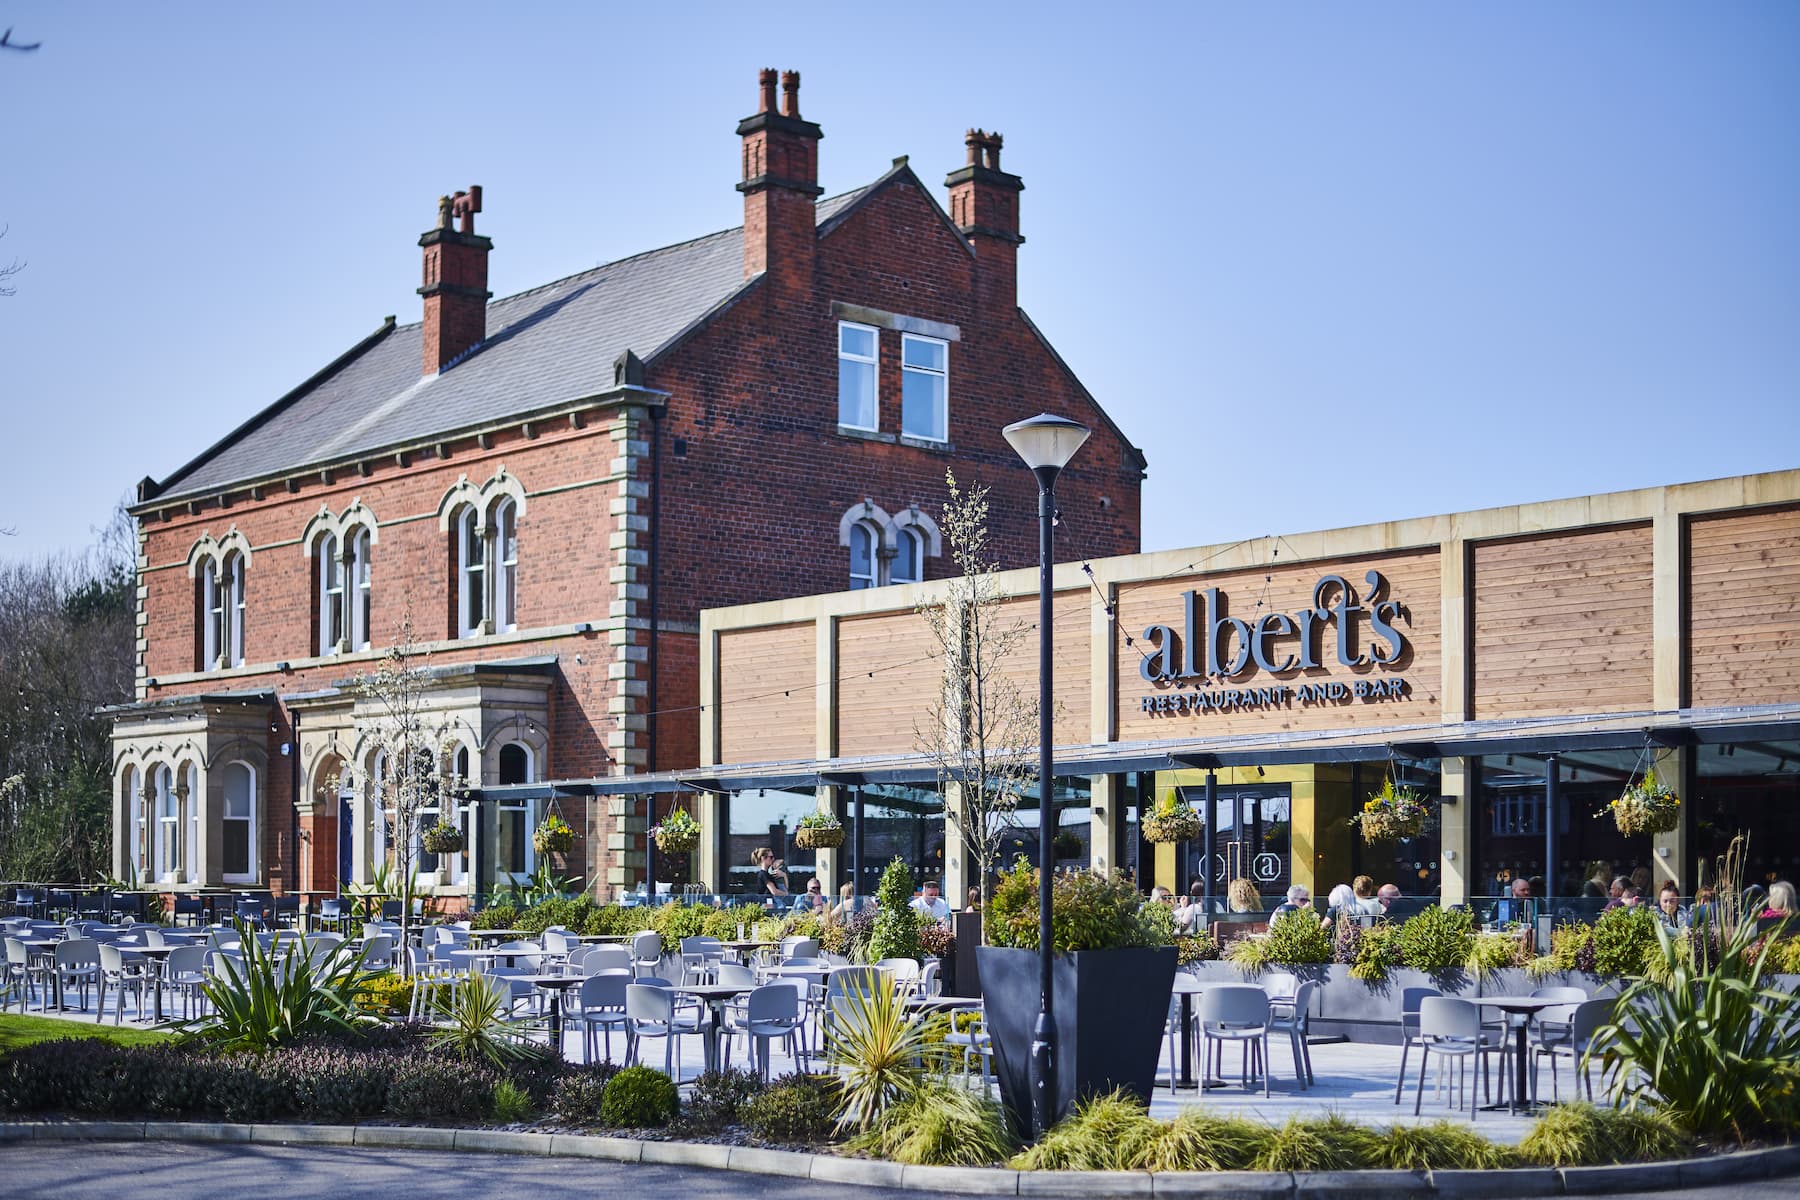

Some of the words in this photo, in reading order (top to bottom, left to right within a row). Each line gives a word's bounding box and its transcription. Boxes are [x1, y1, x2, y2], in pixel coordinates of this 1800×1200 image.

[1139, 570, 1402, 682] albert's
[1141, 685, 1287, 712] RESTAURANT
[1296, 682, 1344, 701] AND
[1354, 677, 1402, 697] BAR
[1261, 856, 1276, 876] a
